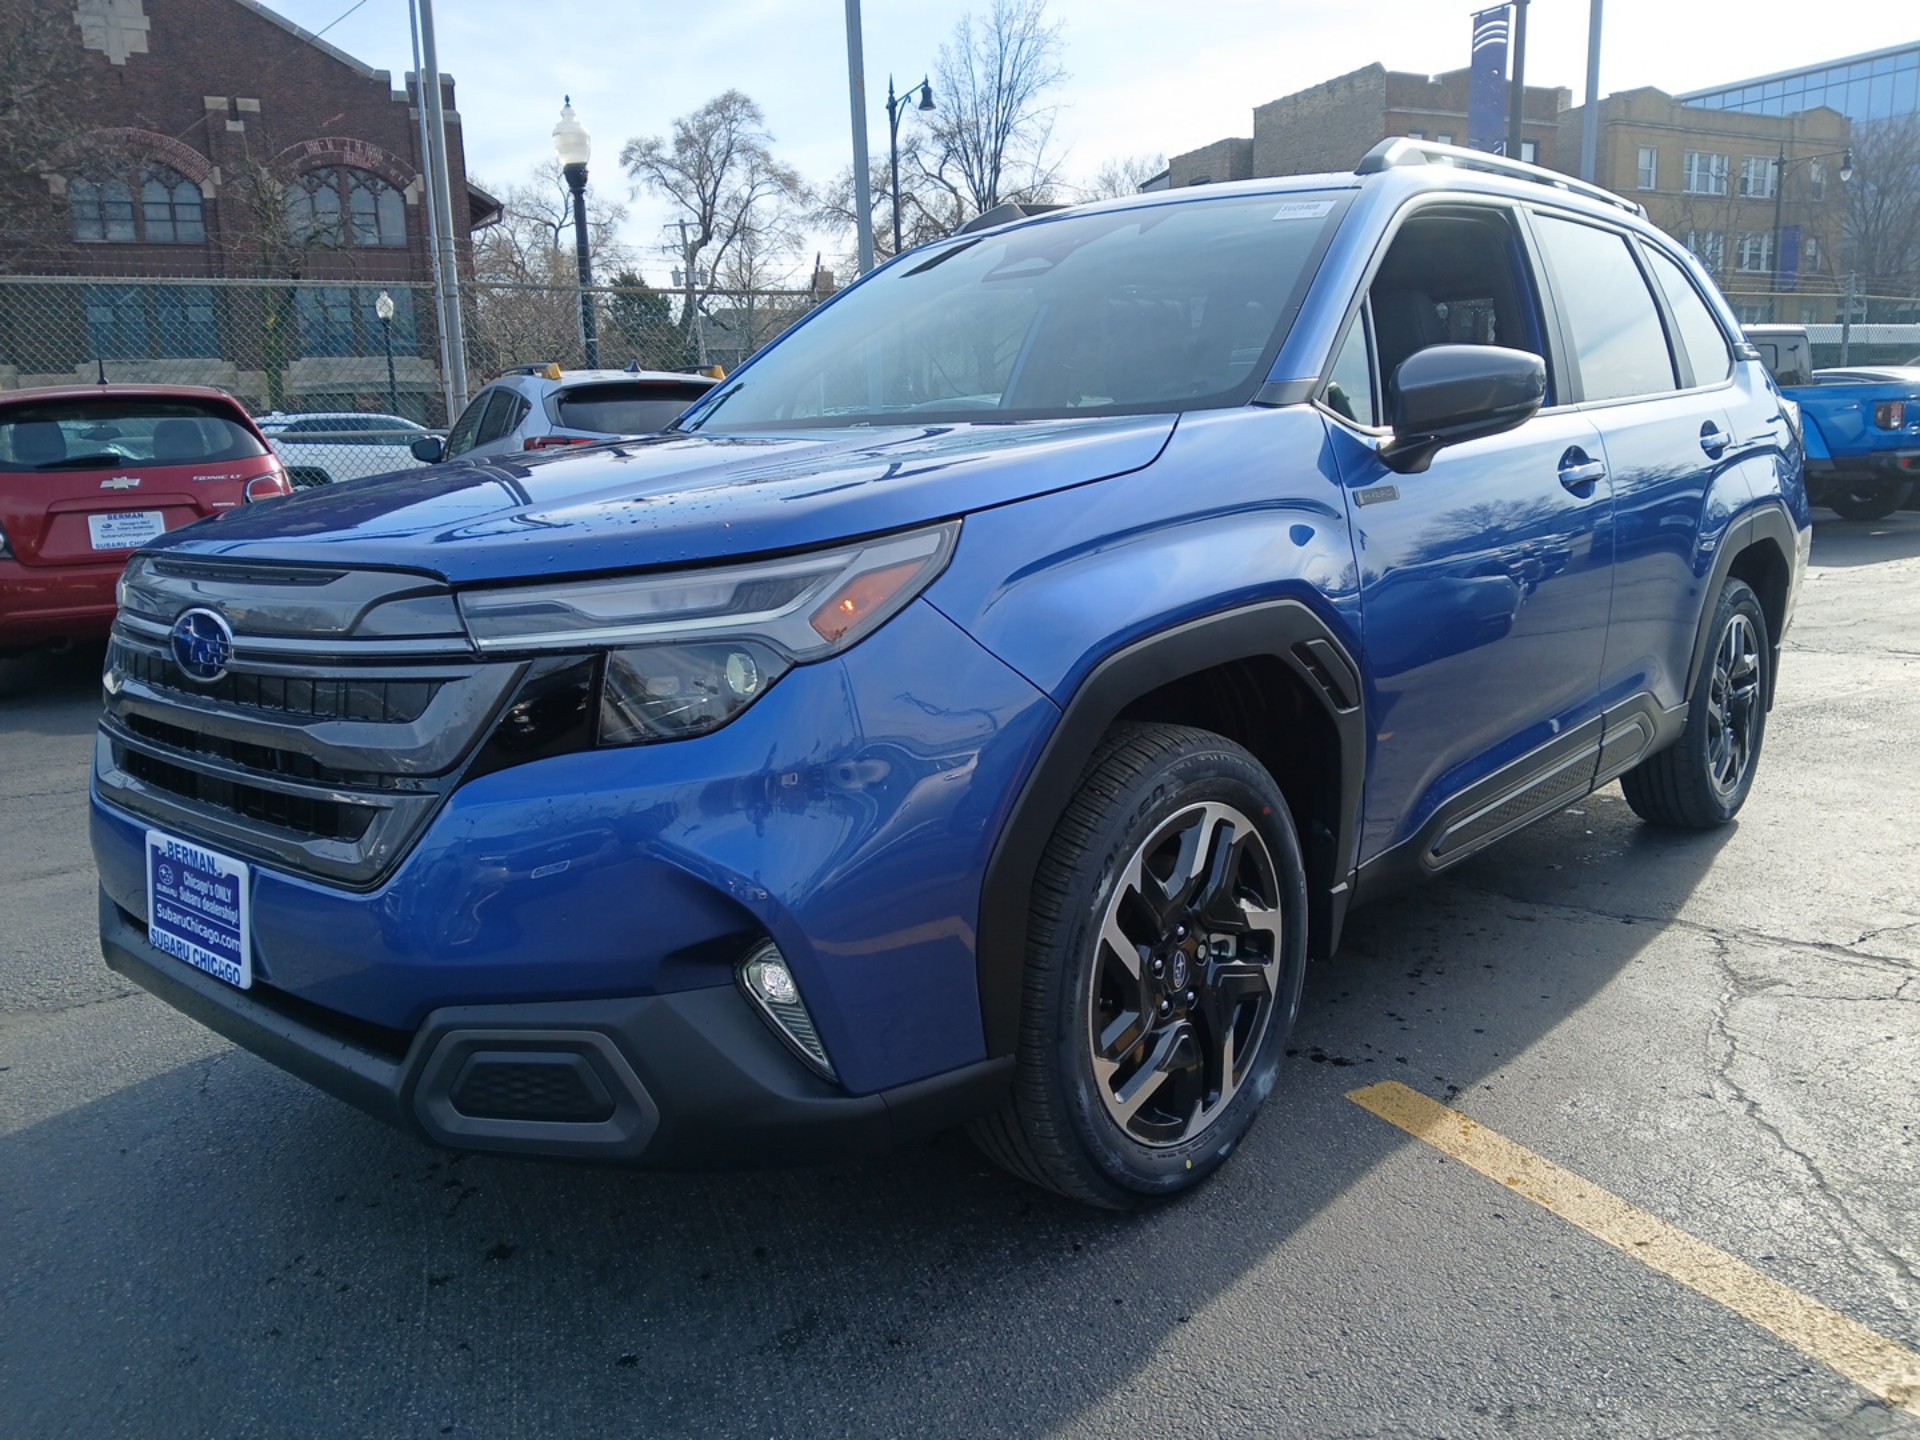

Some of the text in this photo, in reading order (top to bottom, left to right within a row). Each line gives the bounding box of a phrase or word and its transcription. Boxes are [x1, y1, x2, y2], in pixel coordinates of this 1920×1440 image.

[107, 513, 144, 521] BERMAN
[95, 539, 148, 549] SUBARU CHIC
[101, 531, 156, 539] SubaruChicago.com
[167, 841, 217, 875] BERMAN
[183, 871, 232, 903] Chicago's ONLY
[179, 886, 239, 926] Subaru dealership!
[156, 904, 241, 953] SubaruChicago.com
[150, 928, 241, 986] SUBARU CHICAGO
